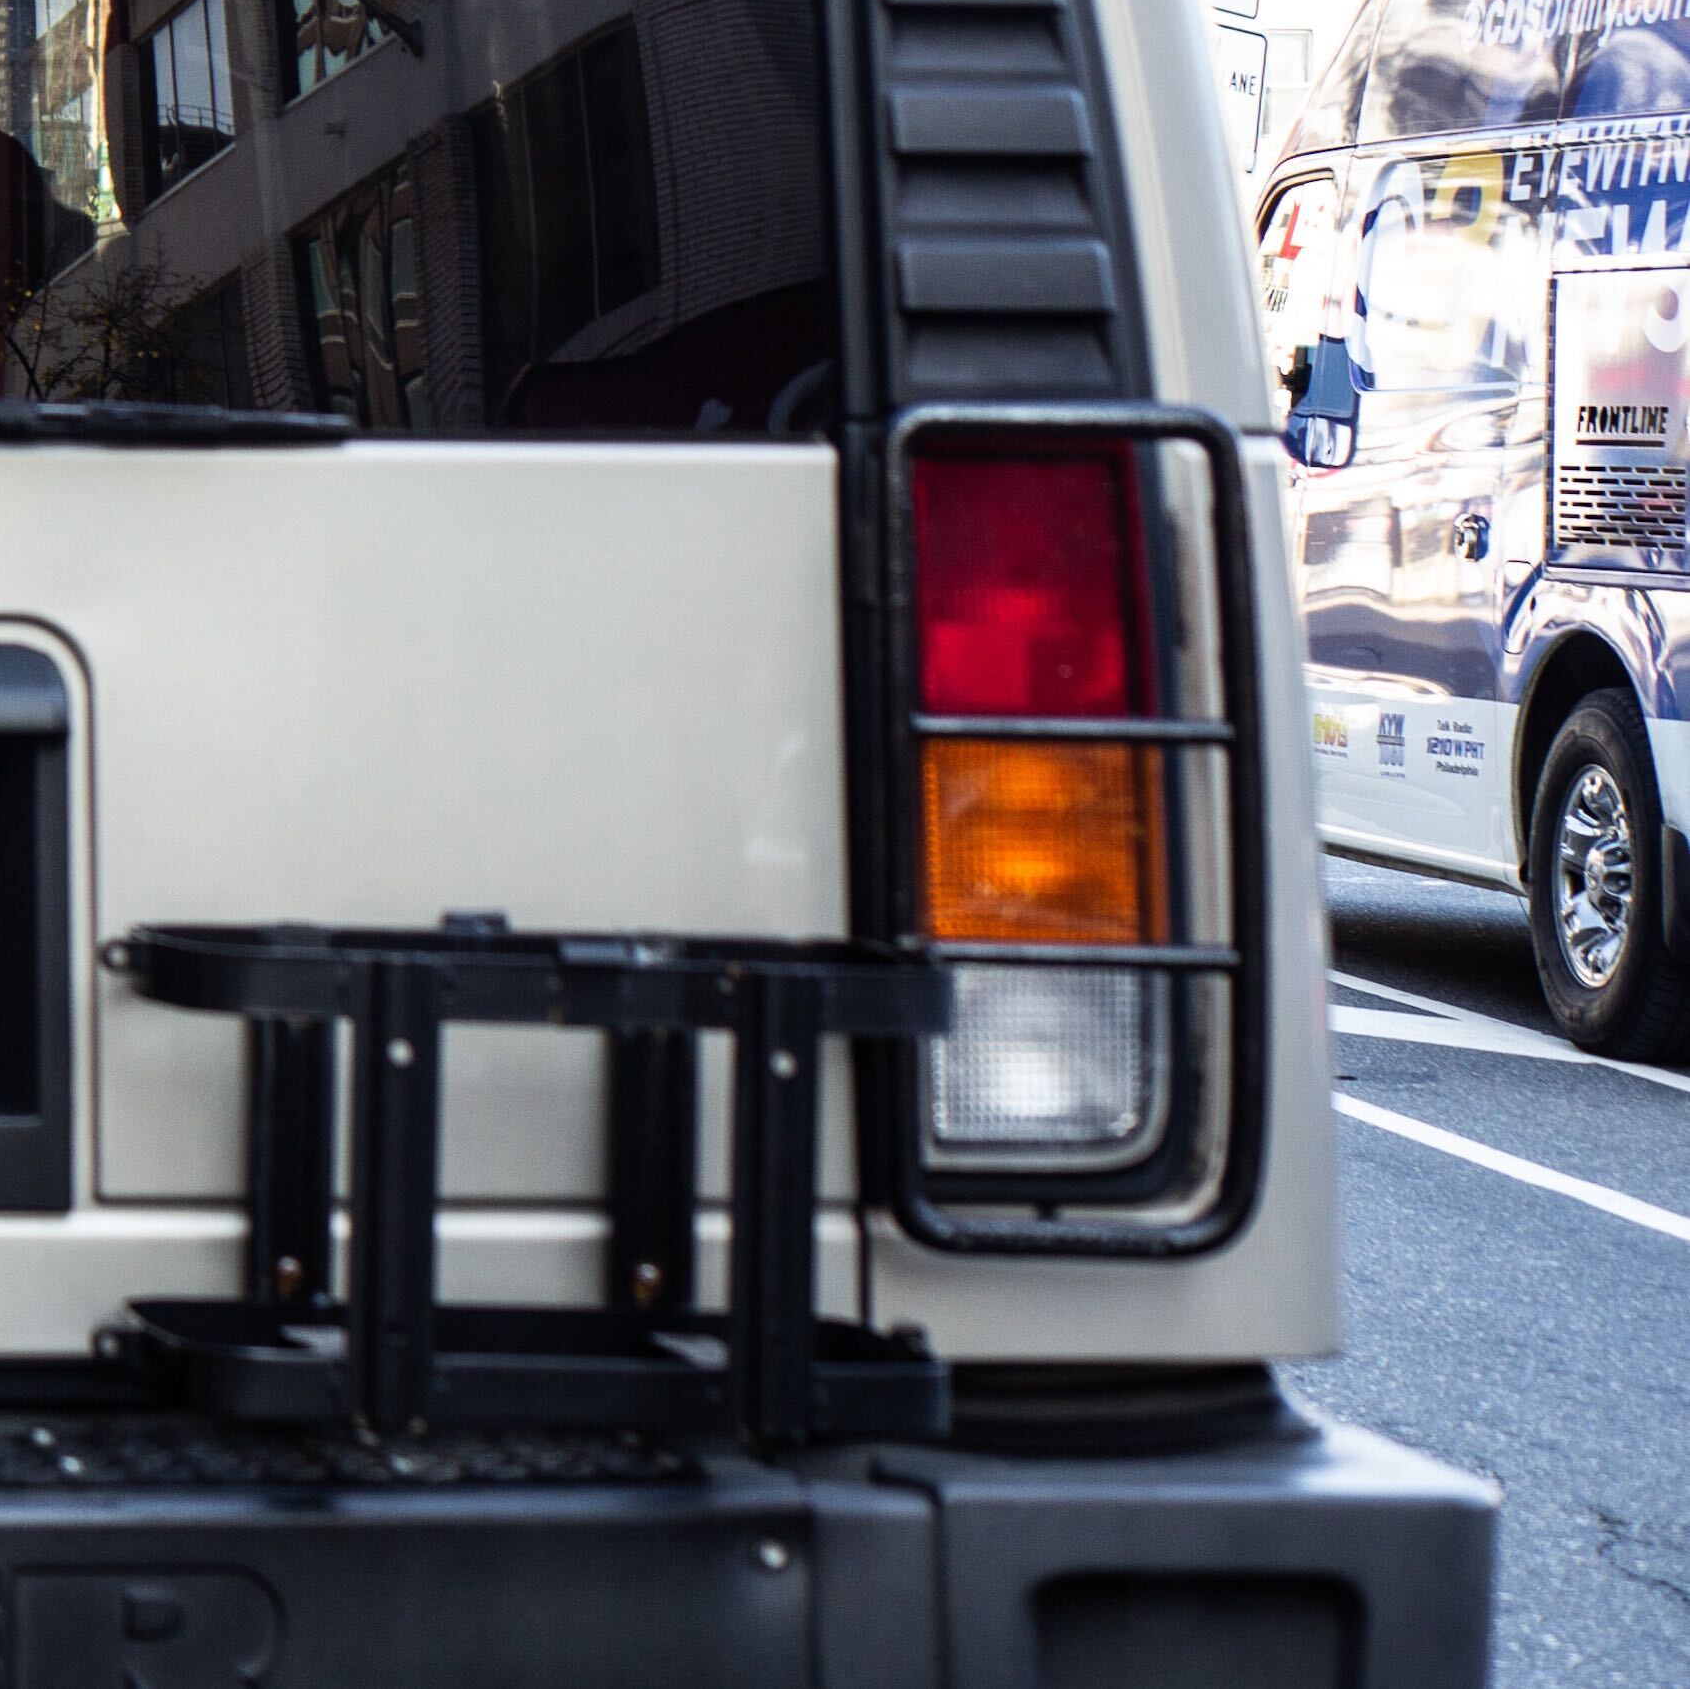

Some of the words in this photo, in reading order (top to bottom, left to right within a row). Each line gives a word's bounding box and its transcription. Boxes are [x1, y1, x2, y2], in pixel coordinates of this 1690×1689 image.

[1577, 406, 1669, 434] FRONTLINE
[1379, 713, 1405, 737] KYW
[1427, 736, 1452, 756] 1210
